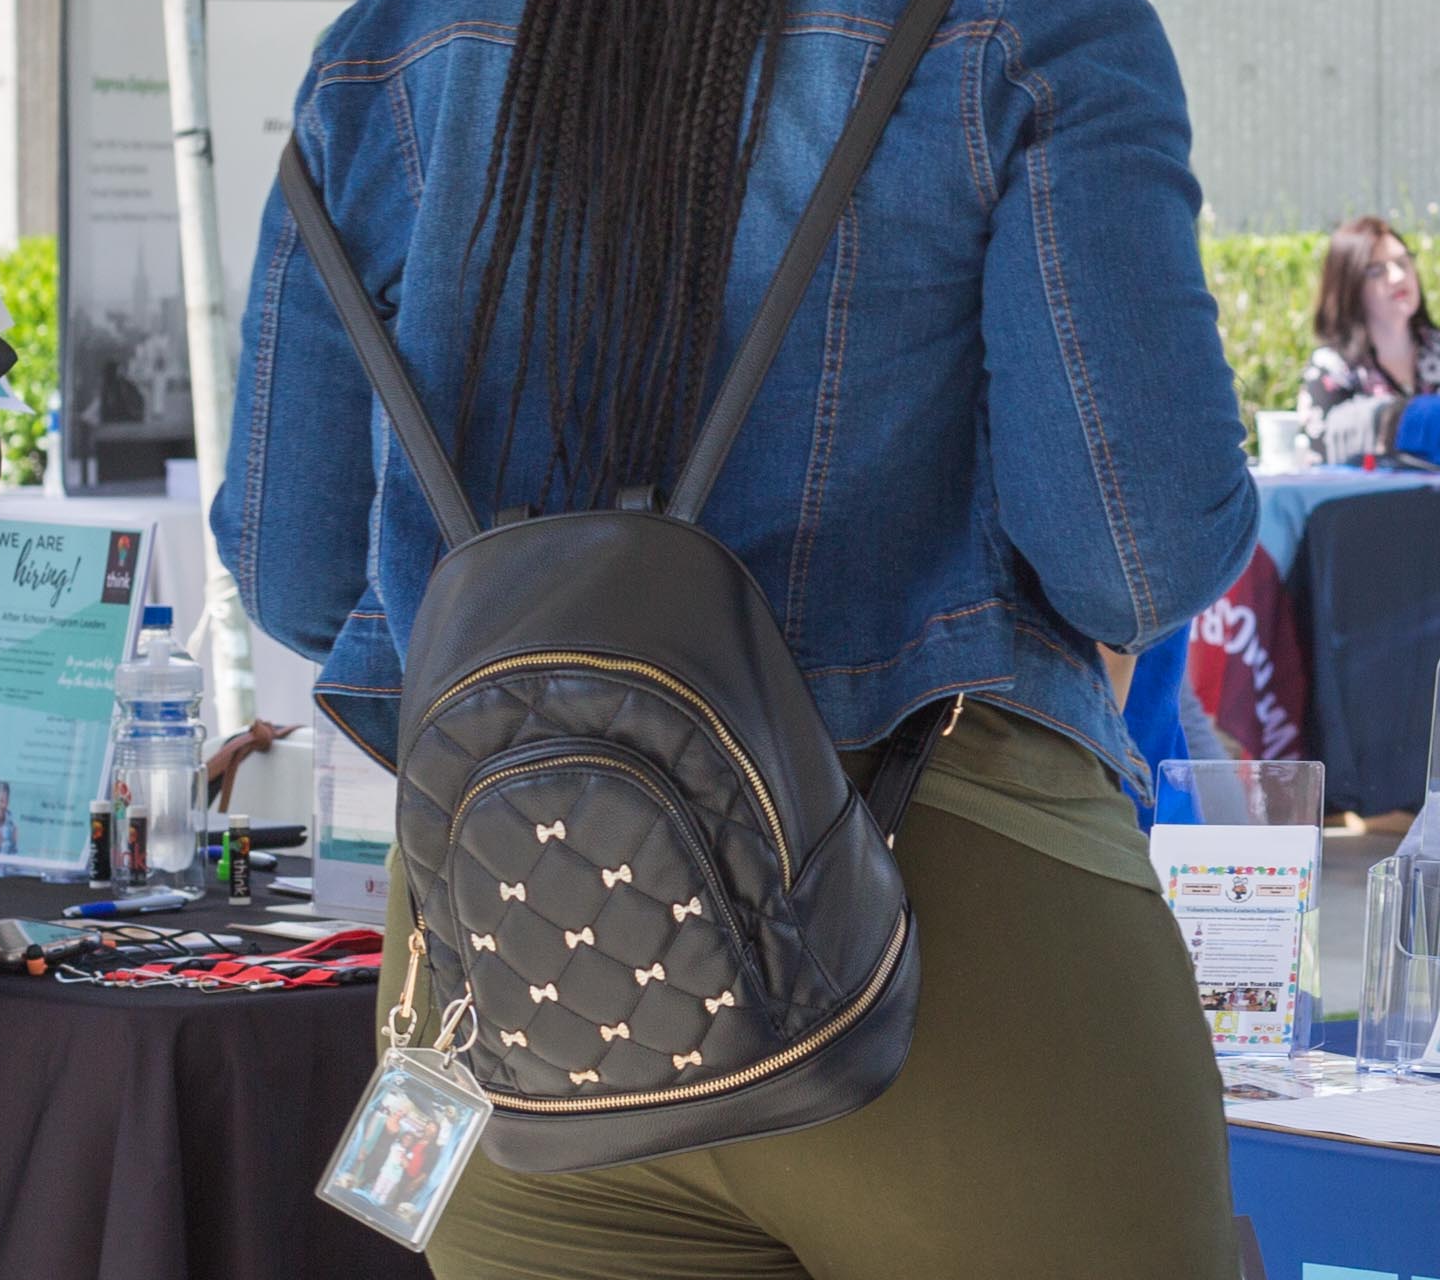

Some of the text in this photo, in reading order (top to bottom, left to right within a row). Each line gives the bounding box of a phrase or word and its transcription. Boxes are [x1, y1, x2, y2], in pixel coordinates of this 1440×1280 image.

[35, 534, 65, 553] ARE
[12, 537, 82, 609] hiring!
[106, 571, 131, 590] think
[2, 610, 106, 631] After School Program Leaders
[233, 859, 248, 897] think
